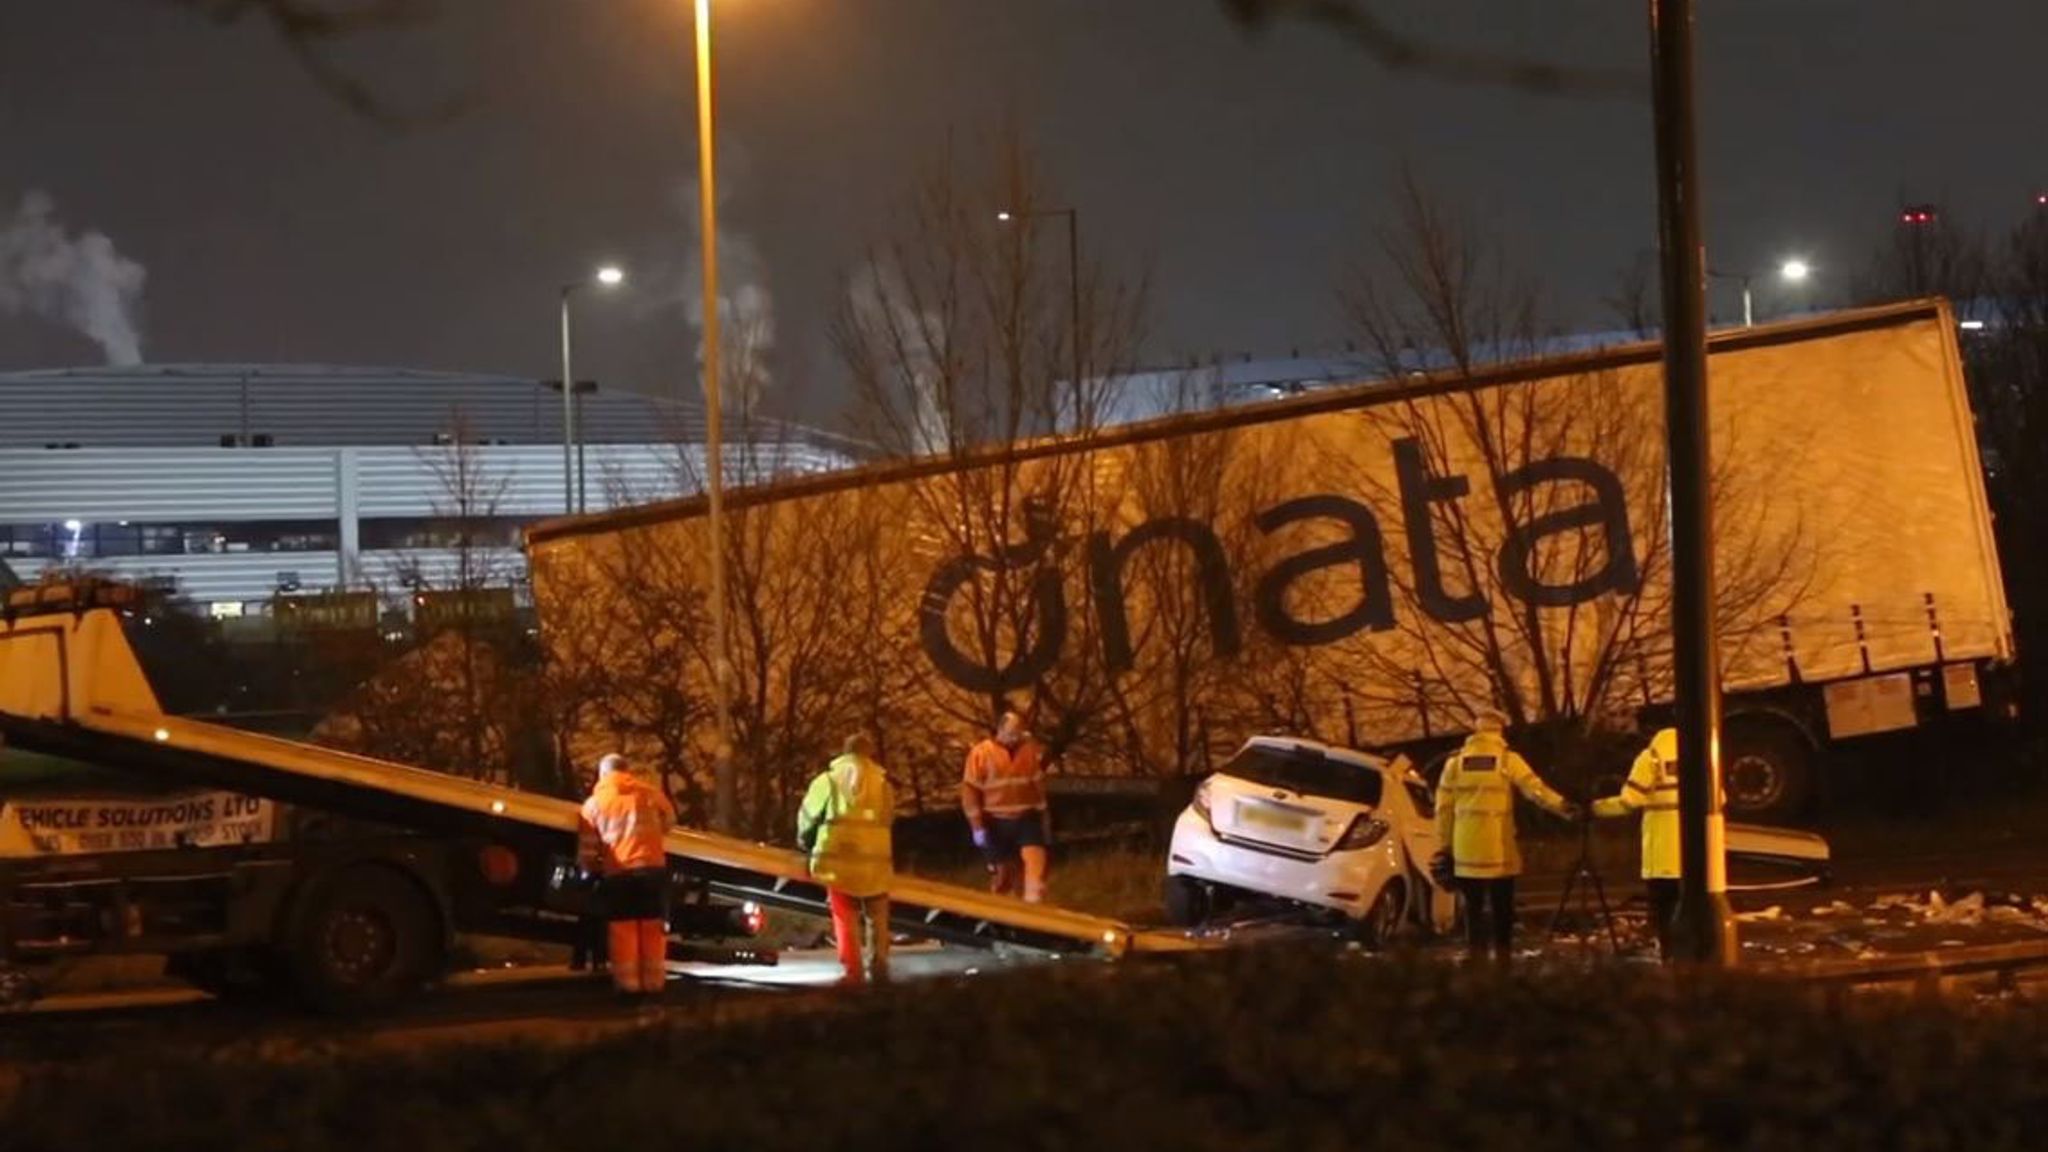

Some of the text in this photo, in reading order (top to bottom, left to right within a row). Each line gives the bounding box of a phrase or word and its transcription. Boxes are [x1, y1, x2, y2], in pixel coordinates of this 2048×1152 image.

[919, 435, 1640, 695] dnata
[97, 799, 215, 827] SOLUTIONS
[223, 796, 260, 819] LTD
